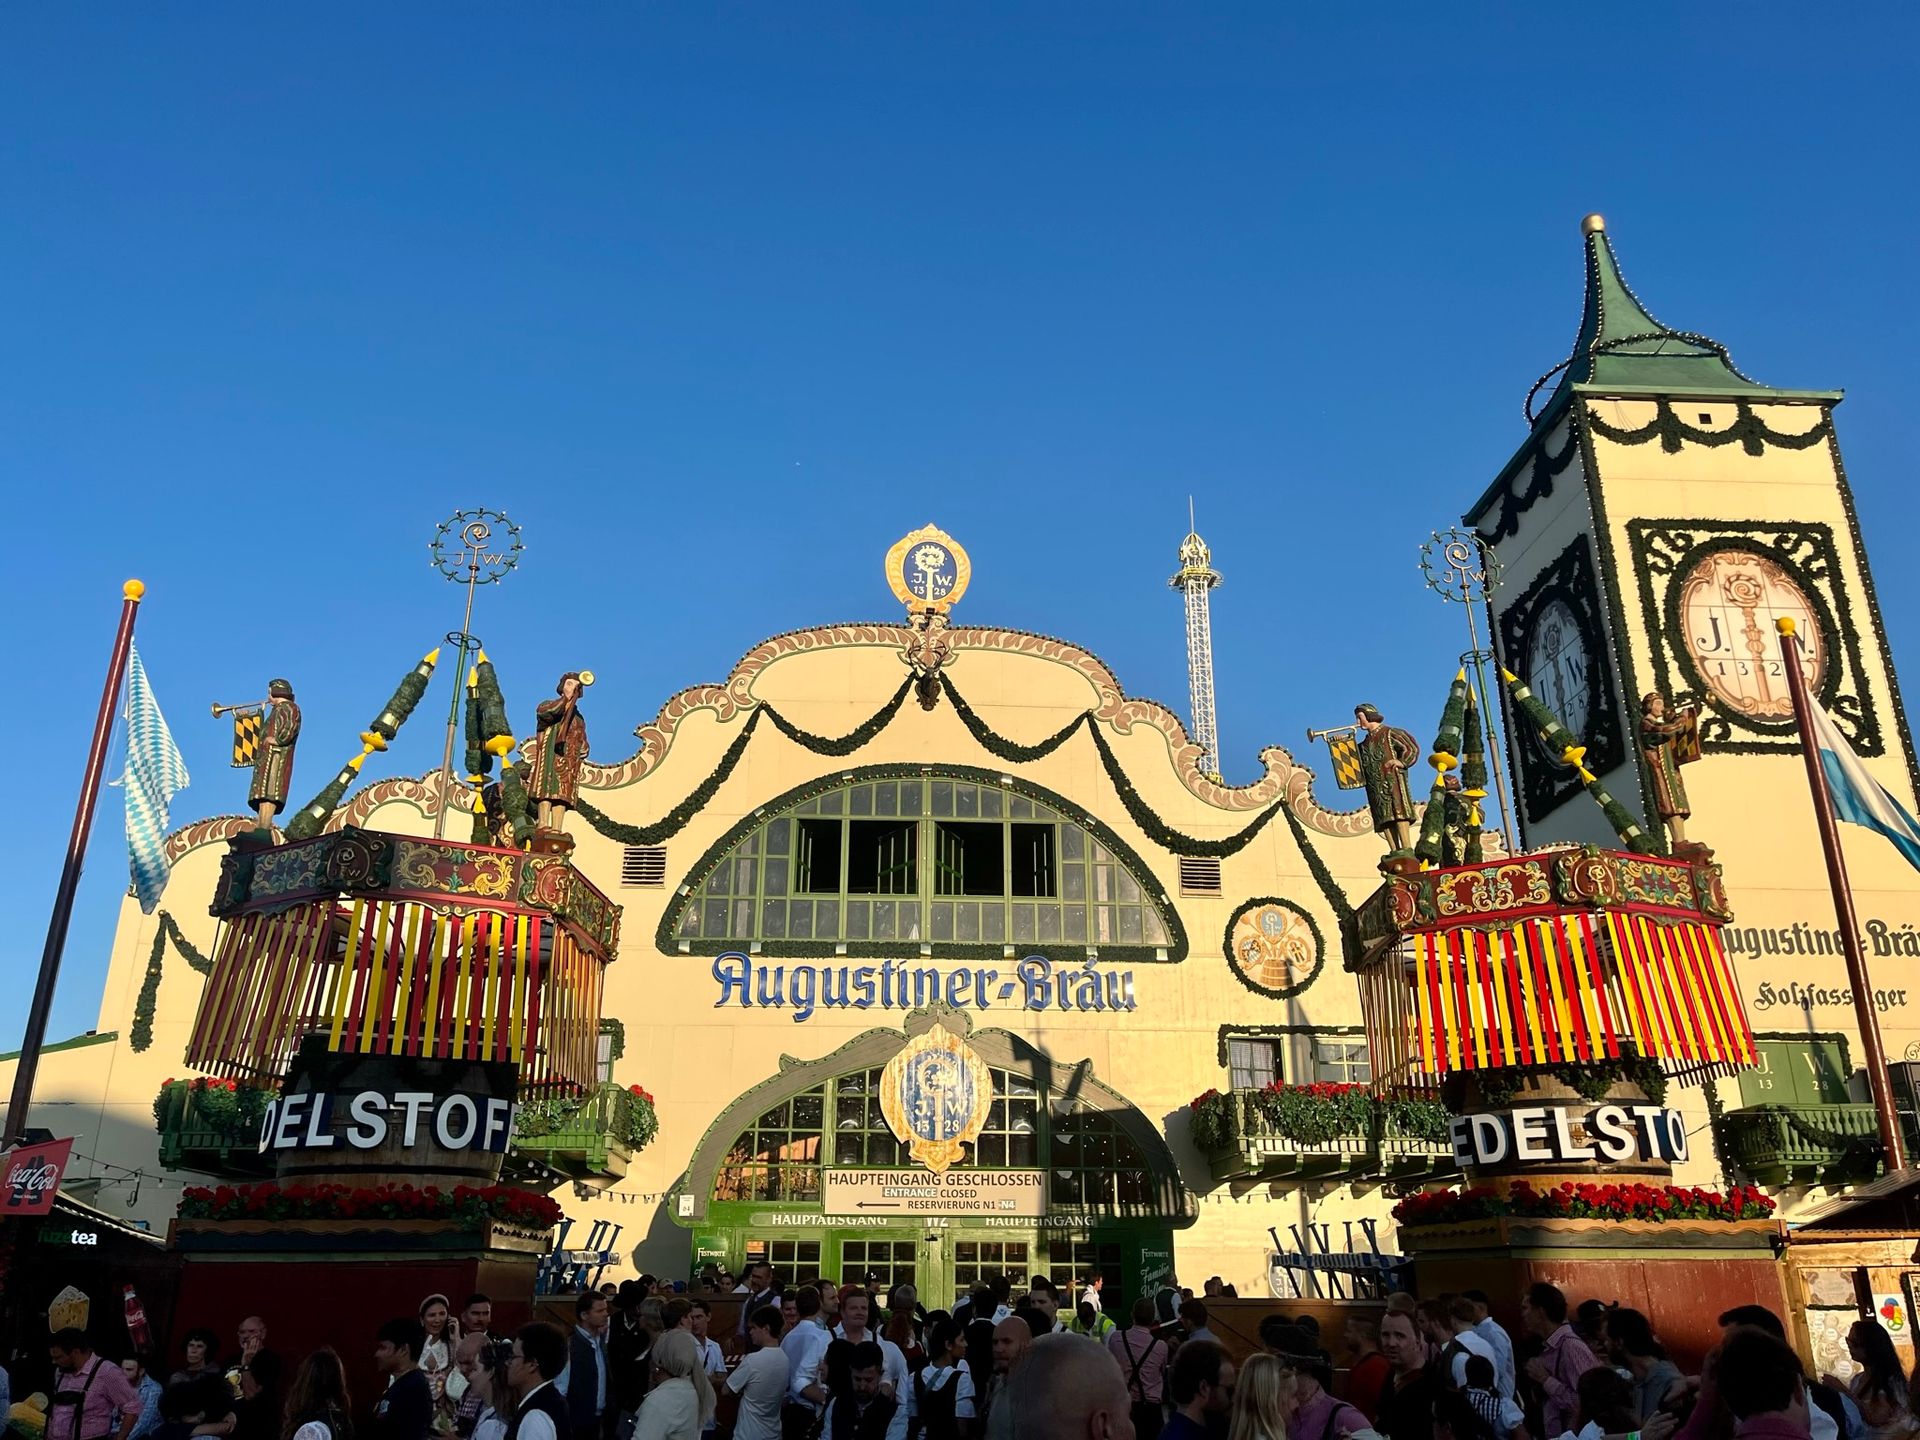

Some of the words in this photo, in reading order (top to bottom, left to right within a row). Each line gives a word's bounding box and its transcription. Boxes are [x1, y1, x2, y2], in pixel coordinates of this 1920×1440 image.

[482, 553, 504, 565] W
[913, 585, 925, 595] 13
[934, 587, 947, 596] 28
[944, 1120, 960, 1132] 28
[829, 1173, 941, 1186] HAUPTEINGANG
[945, 1173, 1042, 1186] GESCHLOSSEN
[884, 1187, 937, 1198] ENTRANCE
[940, 1189, 977, 1198] CLOSED
[907, 1200, 980, 1210] RESERVIERUNG
[772, 1213, 888, 1226] HAUPTAUSGANG
